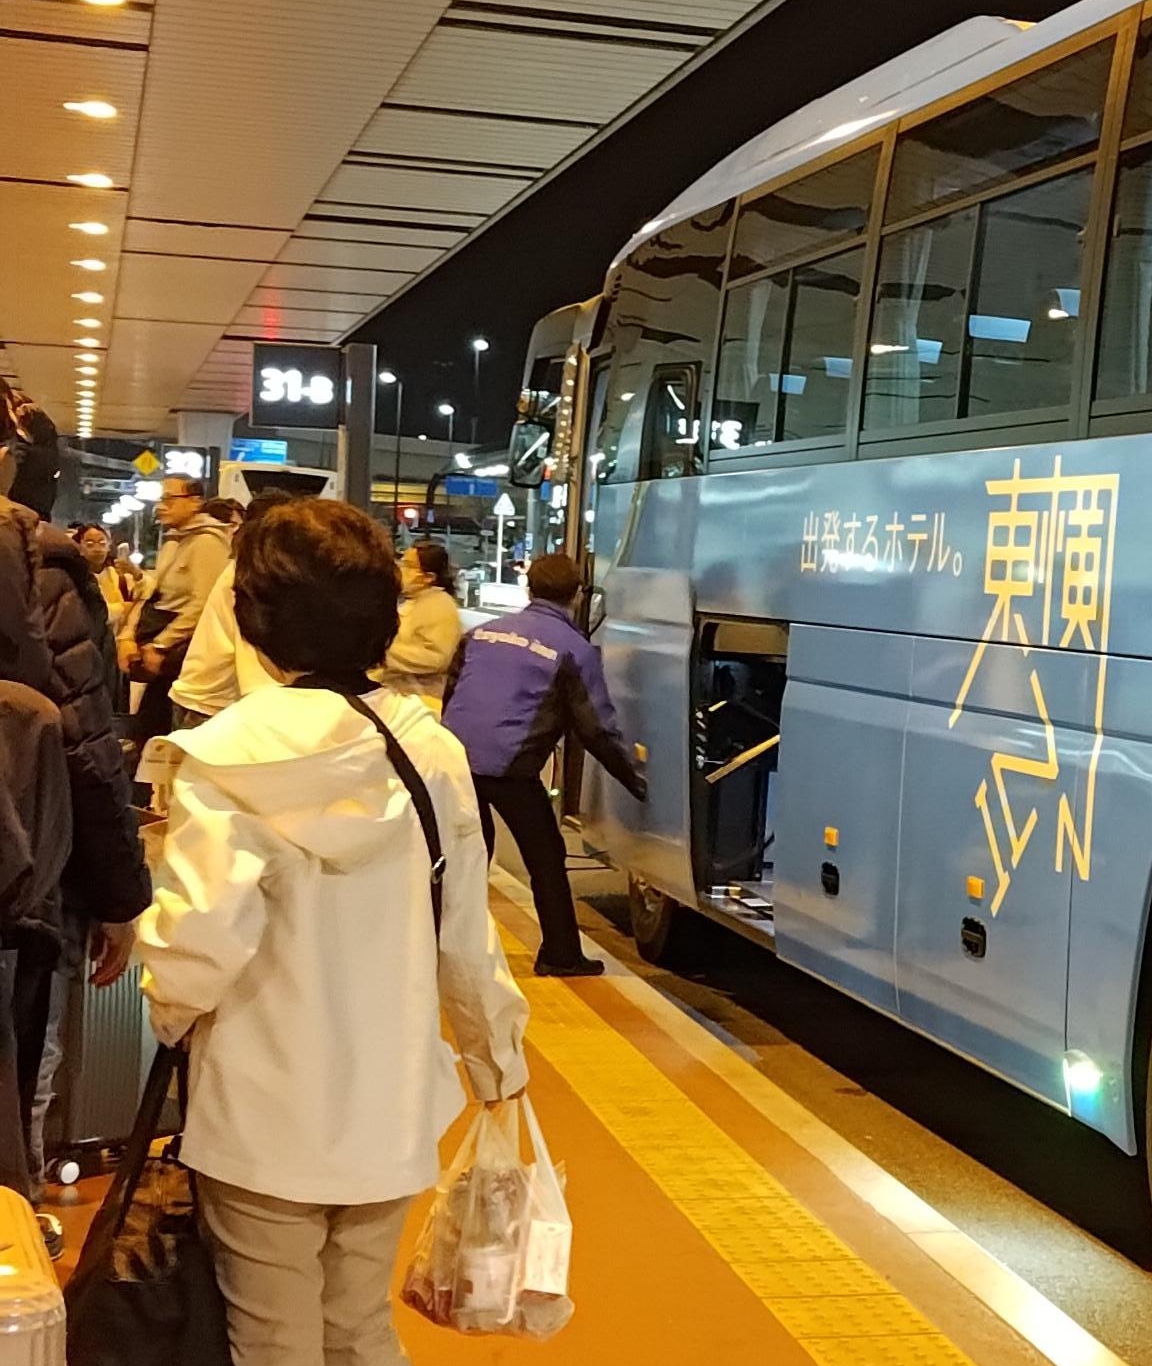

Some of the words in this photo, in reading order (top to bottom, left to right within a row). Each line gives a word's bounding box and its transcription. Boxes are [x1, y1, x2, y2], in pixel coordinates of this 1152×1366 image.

[800, 509, 963, 577] 出発するホテル。
